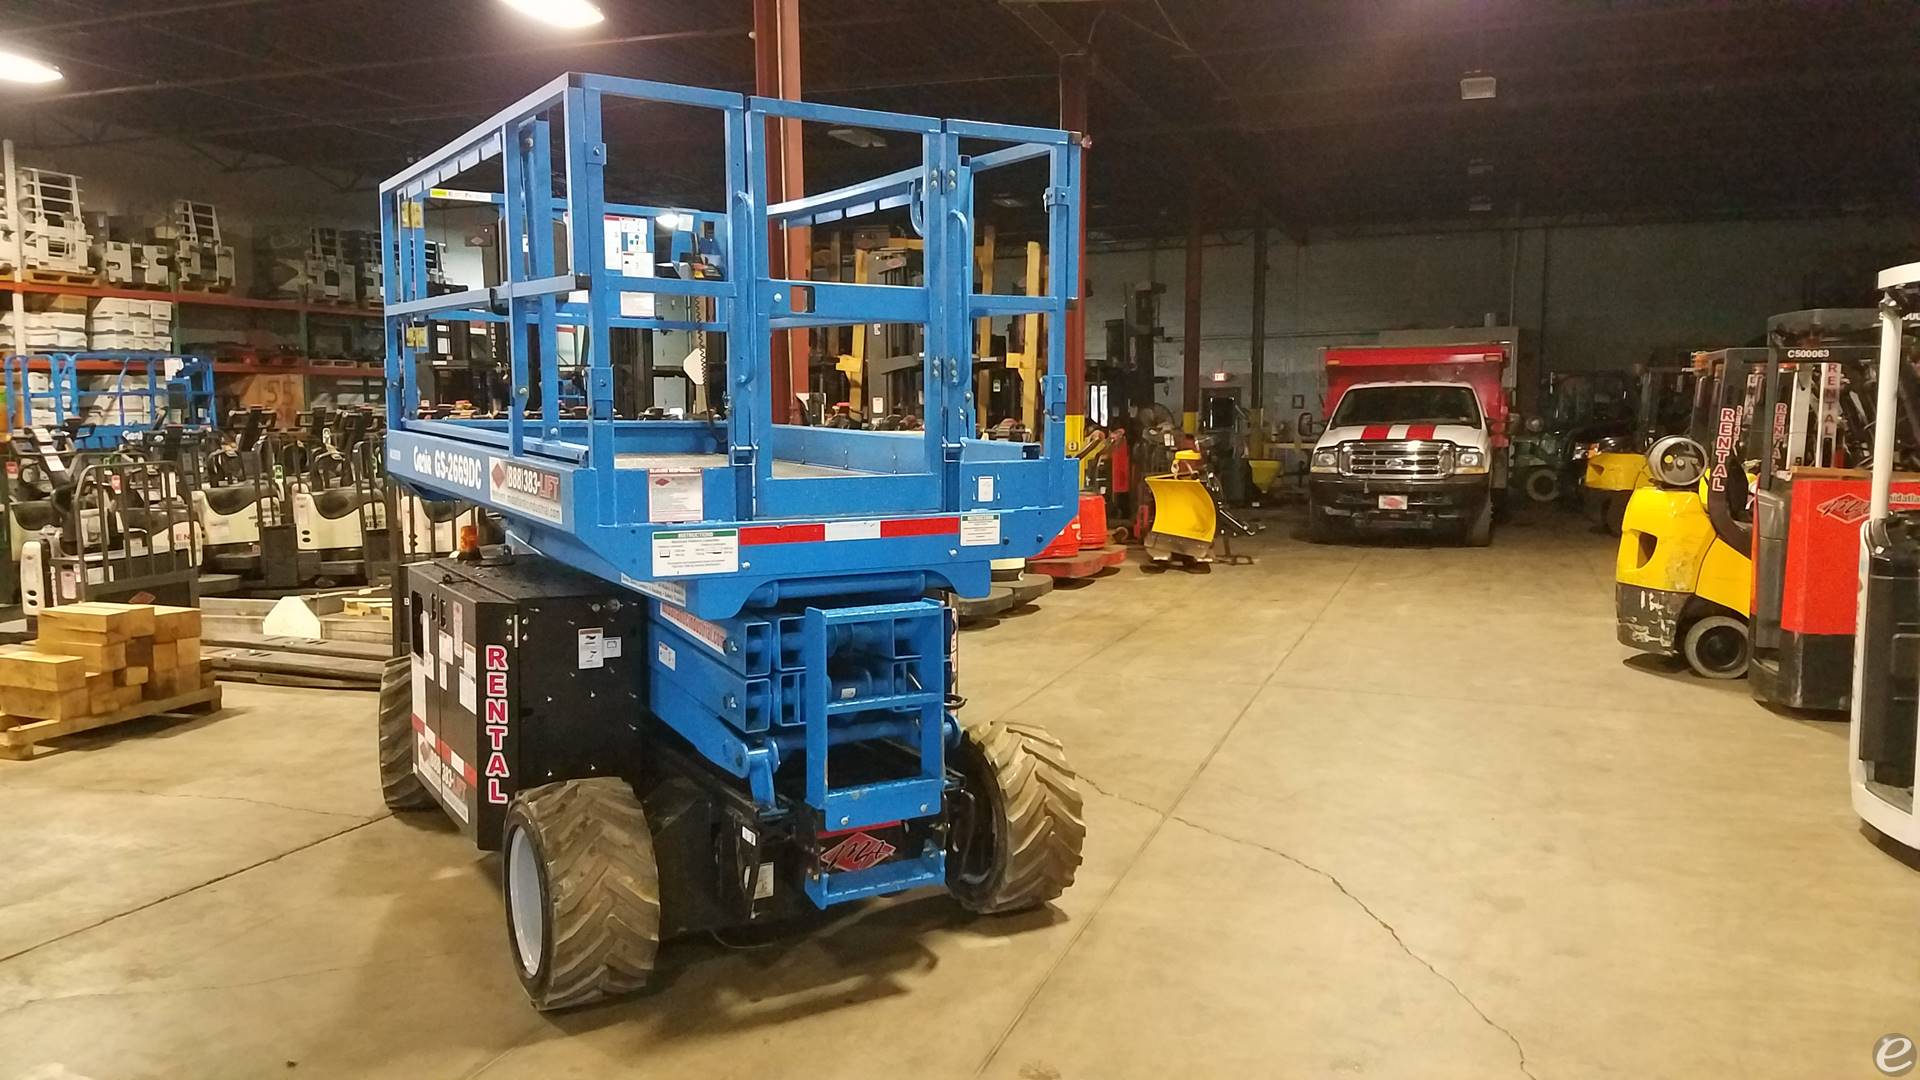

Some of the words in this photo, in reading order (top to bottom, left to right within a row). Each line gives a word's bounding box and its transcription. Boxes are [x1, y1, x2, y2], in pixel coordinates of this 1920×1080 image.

[1787, 350, 1830, 358] C500063
[1825, 363, 1840, 436] RENTAL
[413, 445, 432, 476] Genie
[435, 450, 482, 490] GS-2669DC
[1711, 408, 1735, 491] RENTAL
[485, 644, 509, 804] RENTAL
